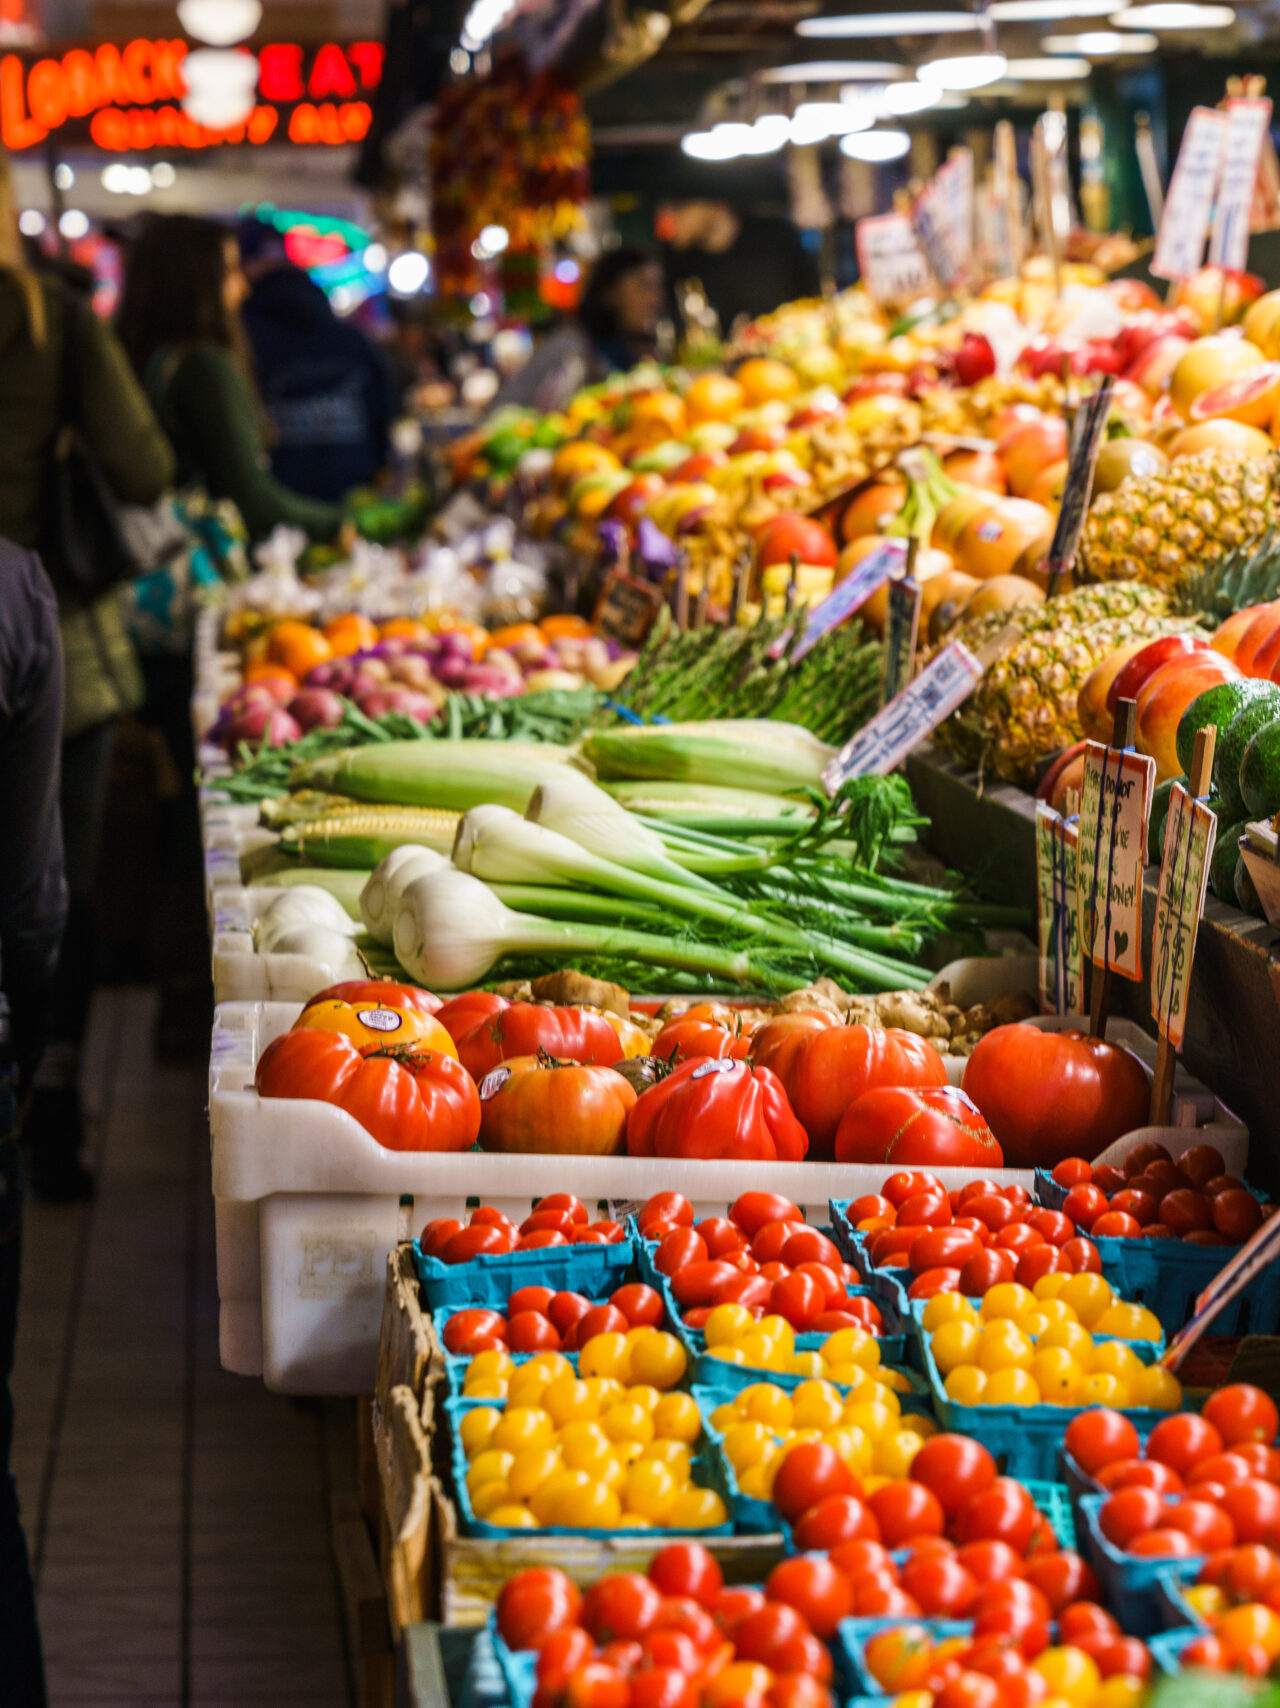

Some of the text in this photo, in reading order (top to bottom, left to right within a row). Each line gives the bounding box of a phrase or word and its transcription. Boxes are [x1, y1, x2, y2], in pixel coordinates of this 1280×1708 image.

[236, 40, 385, 101] EAT
[1107, 827, 1130, 849] YU'RE
[303, 1238, 375, 1277] PPI
